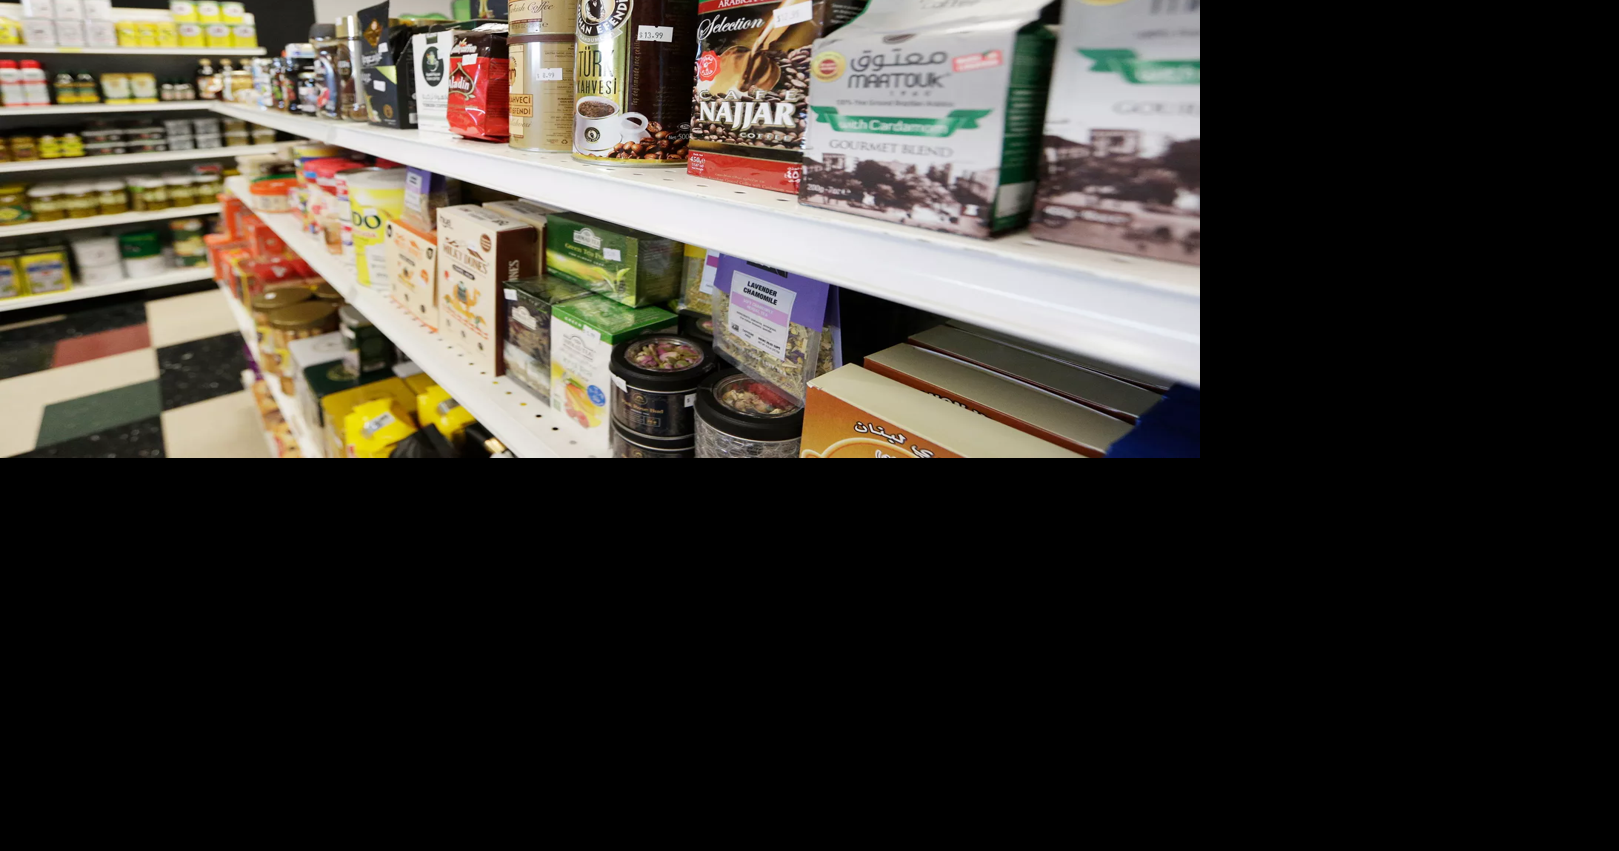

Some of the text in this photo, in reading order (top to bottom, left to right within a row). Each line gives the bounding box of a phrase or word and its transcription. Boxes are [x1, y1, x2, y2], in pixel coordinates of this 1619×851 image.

[527, 1, 555, 13] Coffee
[697, 14, 765, 41] Selection
[578, 46, 615, 77] TÜRK
[850, 48, 949, 72] معتوق
[577, 78, 617, 95] KAHVESİ
[848, 72, 946, 89] MAATOUK
[699, 89, 797, 101] CAFE
[699, 101, 796, 130] NAJJAR
[838, 118, 949, 132] with Cardamom
[739, 132, 792, 142] COFFEE
[828, 139, 954, 158] GOURMET BLEND
[443, 244, 463, 263] MILKY
[463, 254, 488, 275] DUNES
[743, 287, 778, 306] CHAMOMILE
[747, 280, 778, 297] LAVENDER
